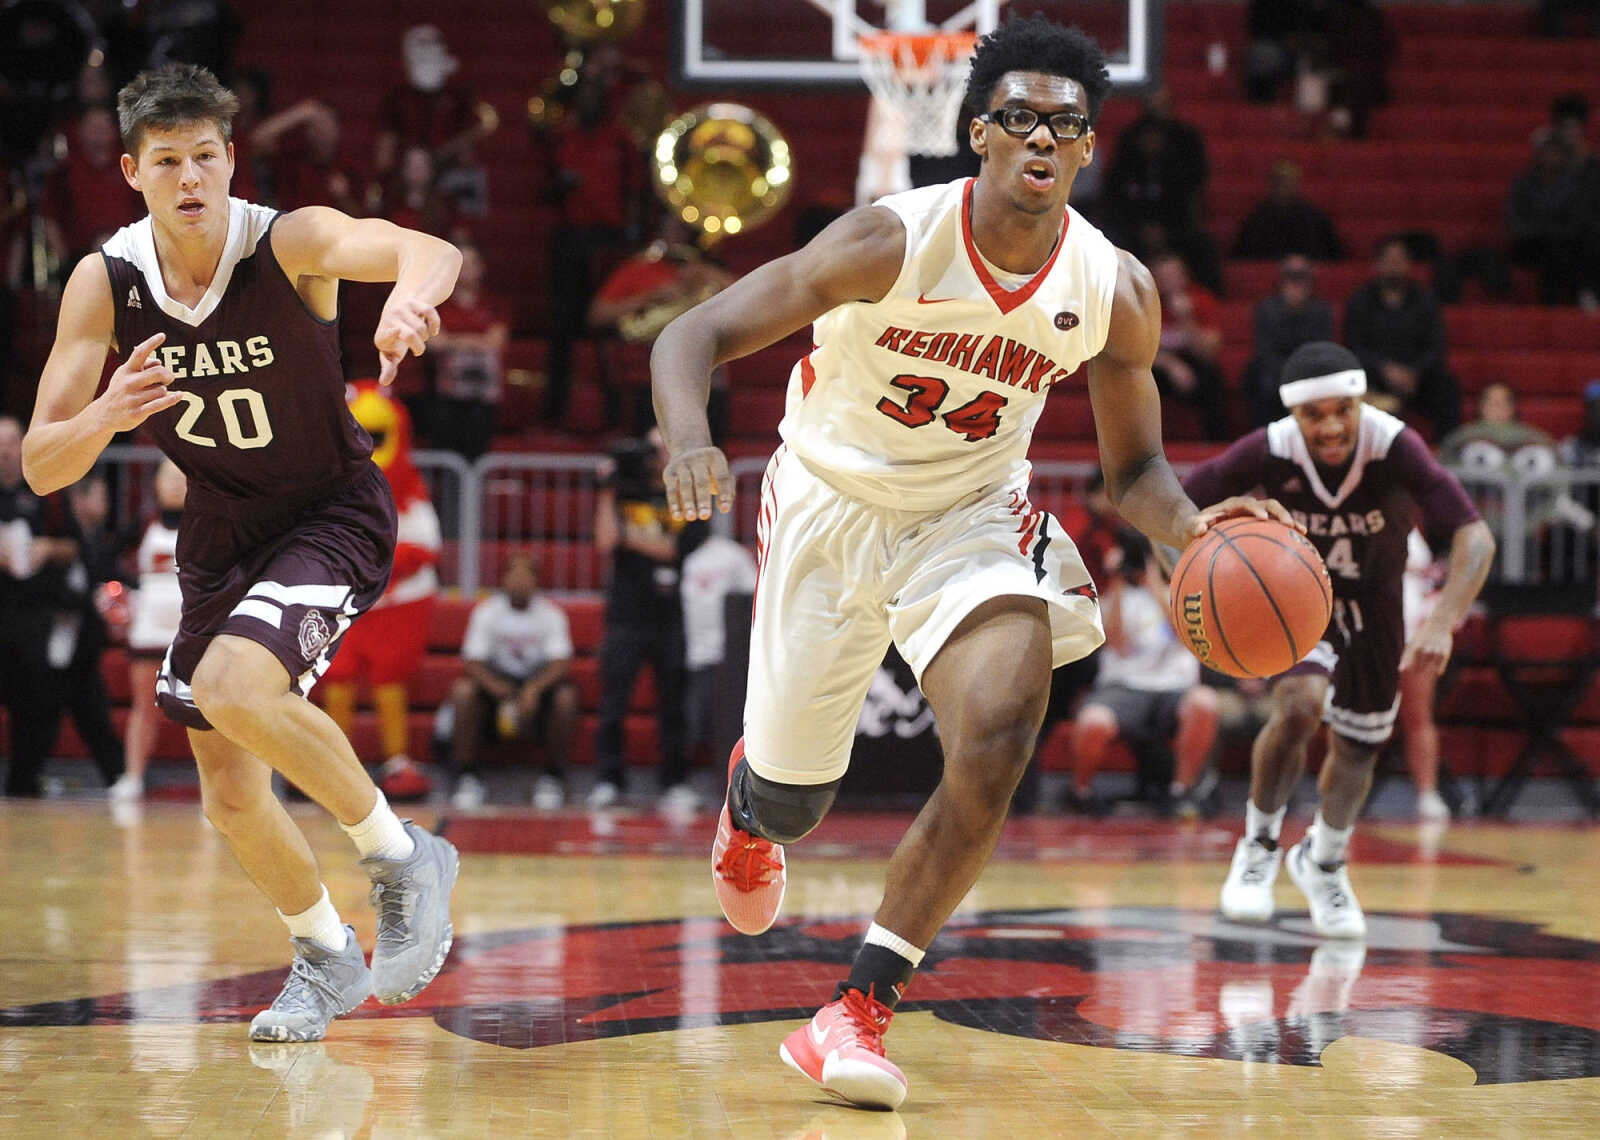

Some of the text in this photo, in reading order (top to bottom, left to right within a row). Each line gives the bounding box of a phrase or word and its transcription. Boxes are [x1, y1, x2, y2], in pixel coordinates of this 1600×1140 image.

[148, 335, 275, 380] EARS
[167, 388, 274, 449] 20
[875, 374, 1009, 442] 34
[1325, 537, 1361, 579] 4
